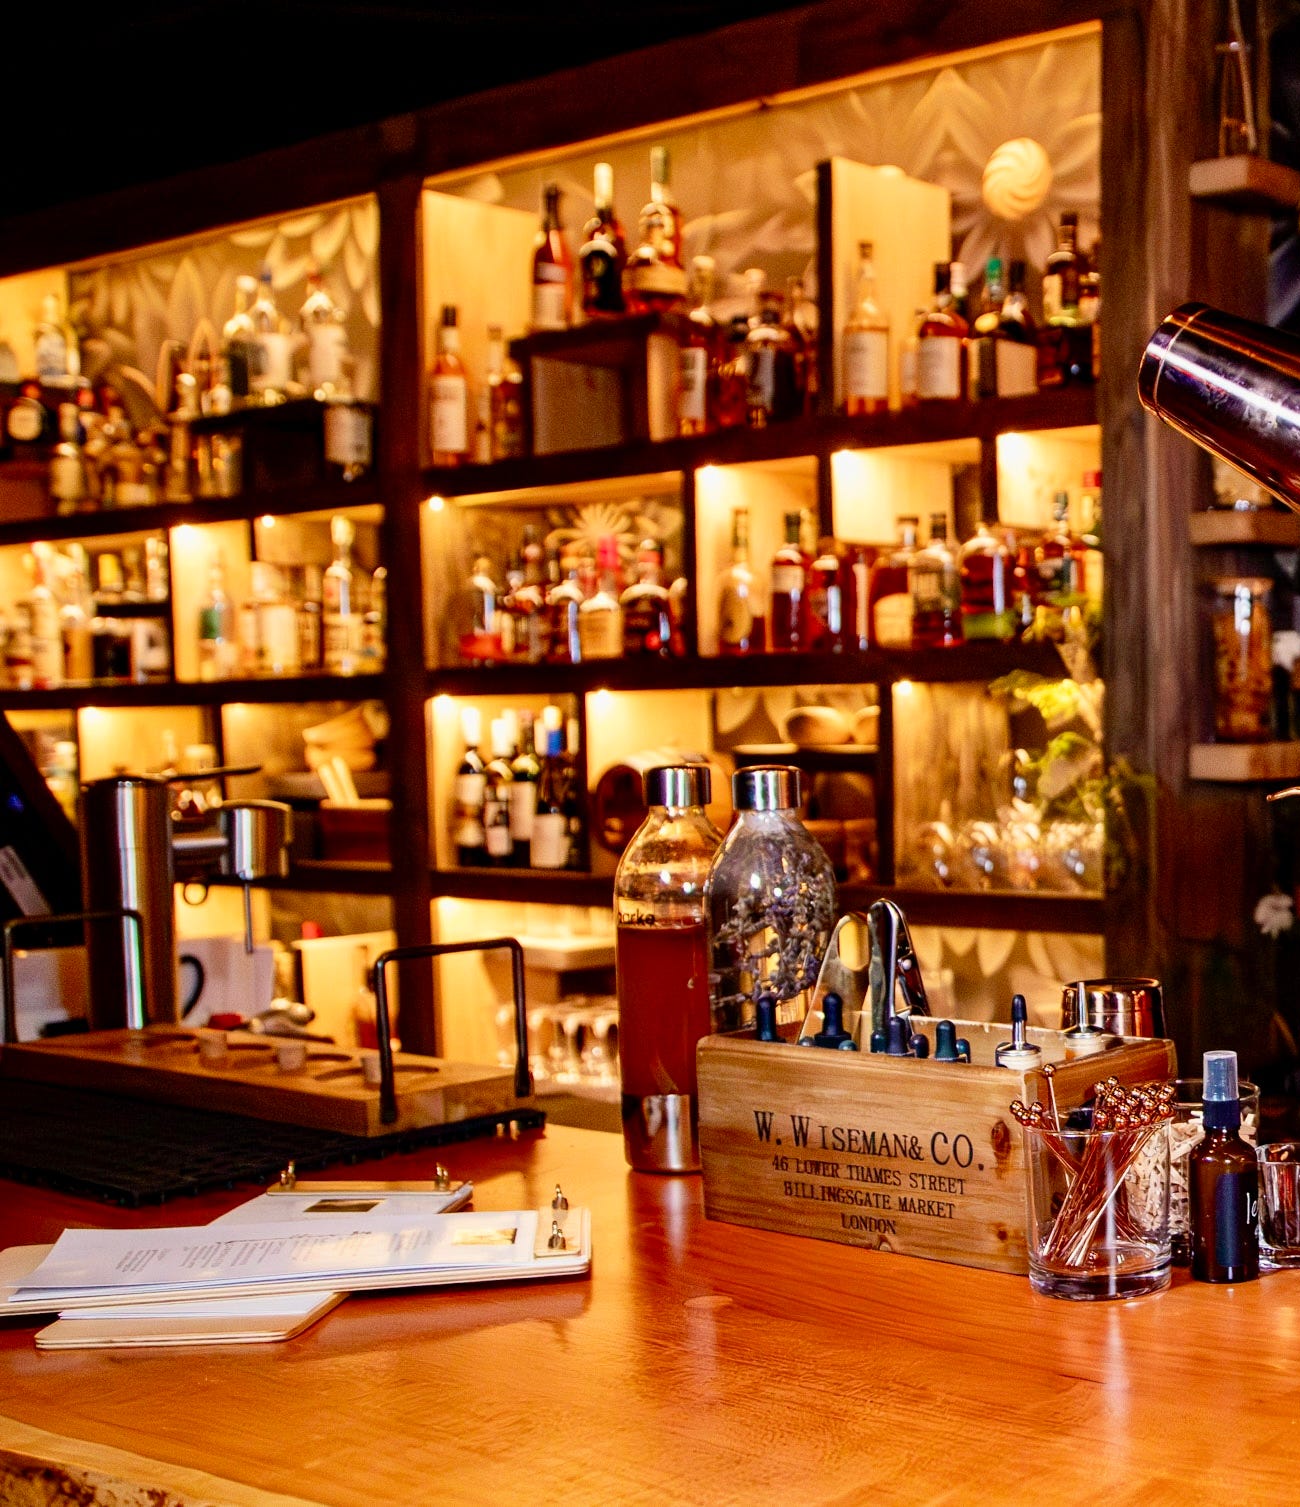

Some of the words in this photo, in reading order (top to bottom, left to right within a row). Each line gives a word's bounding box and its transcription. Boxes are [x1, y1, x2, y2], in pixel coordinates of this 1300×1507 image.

[753, 1110, 782, 1146] W.
[930, 1131, 984, 1171] CO.
[772, 1154, 789, 1171] 46
[796, 1158, 841, 1178] LOWER
[847, 1164, 902, 1187] THAMES
[908, 1172, 966, 1195] STREET
[783, 1181, 892, 1210] BILLINGSGATE
[898, 1196, 956, 1220] MARKET
[841, 1213, 897, 1235] LONDON
